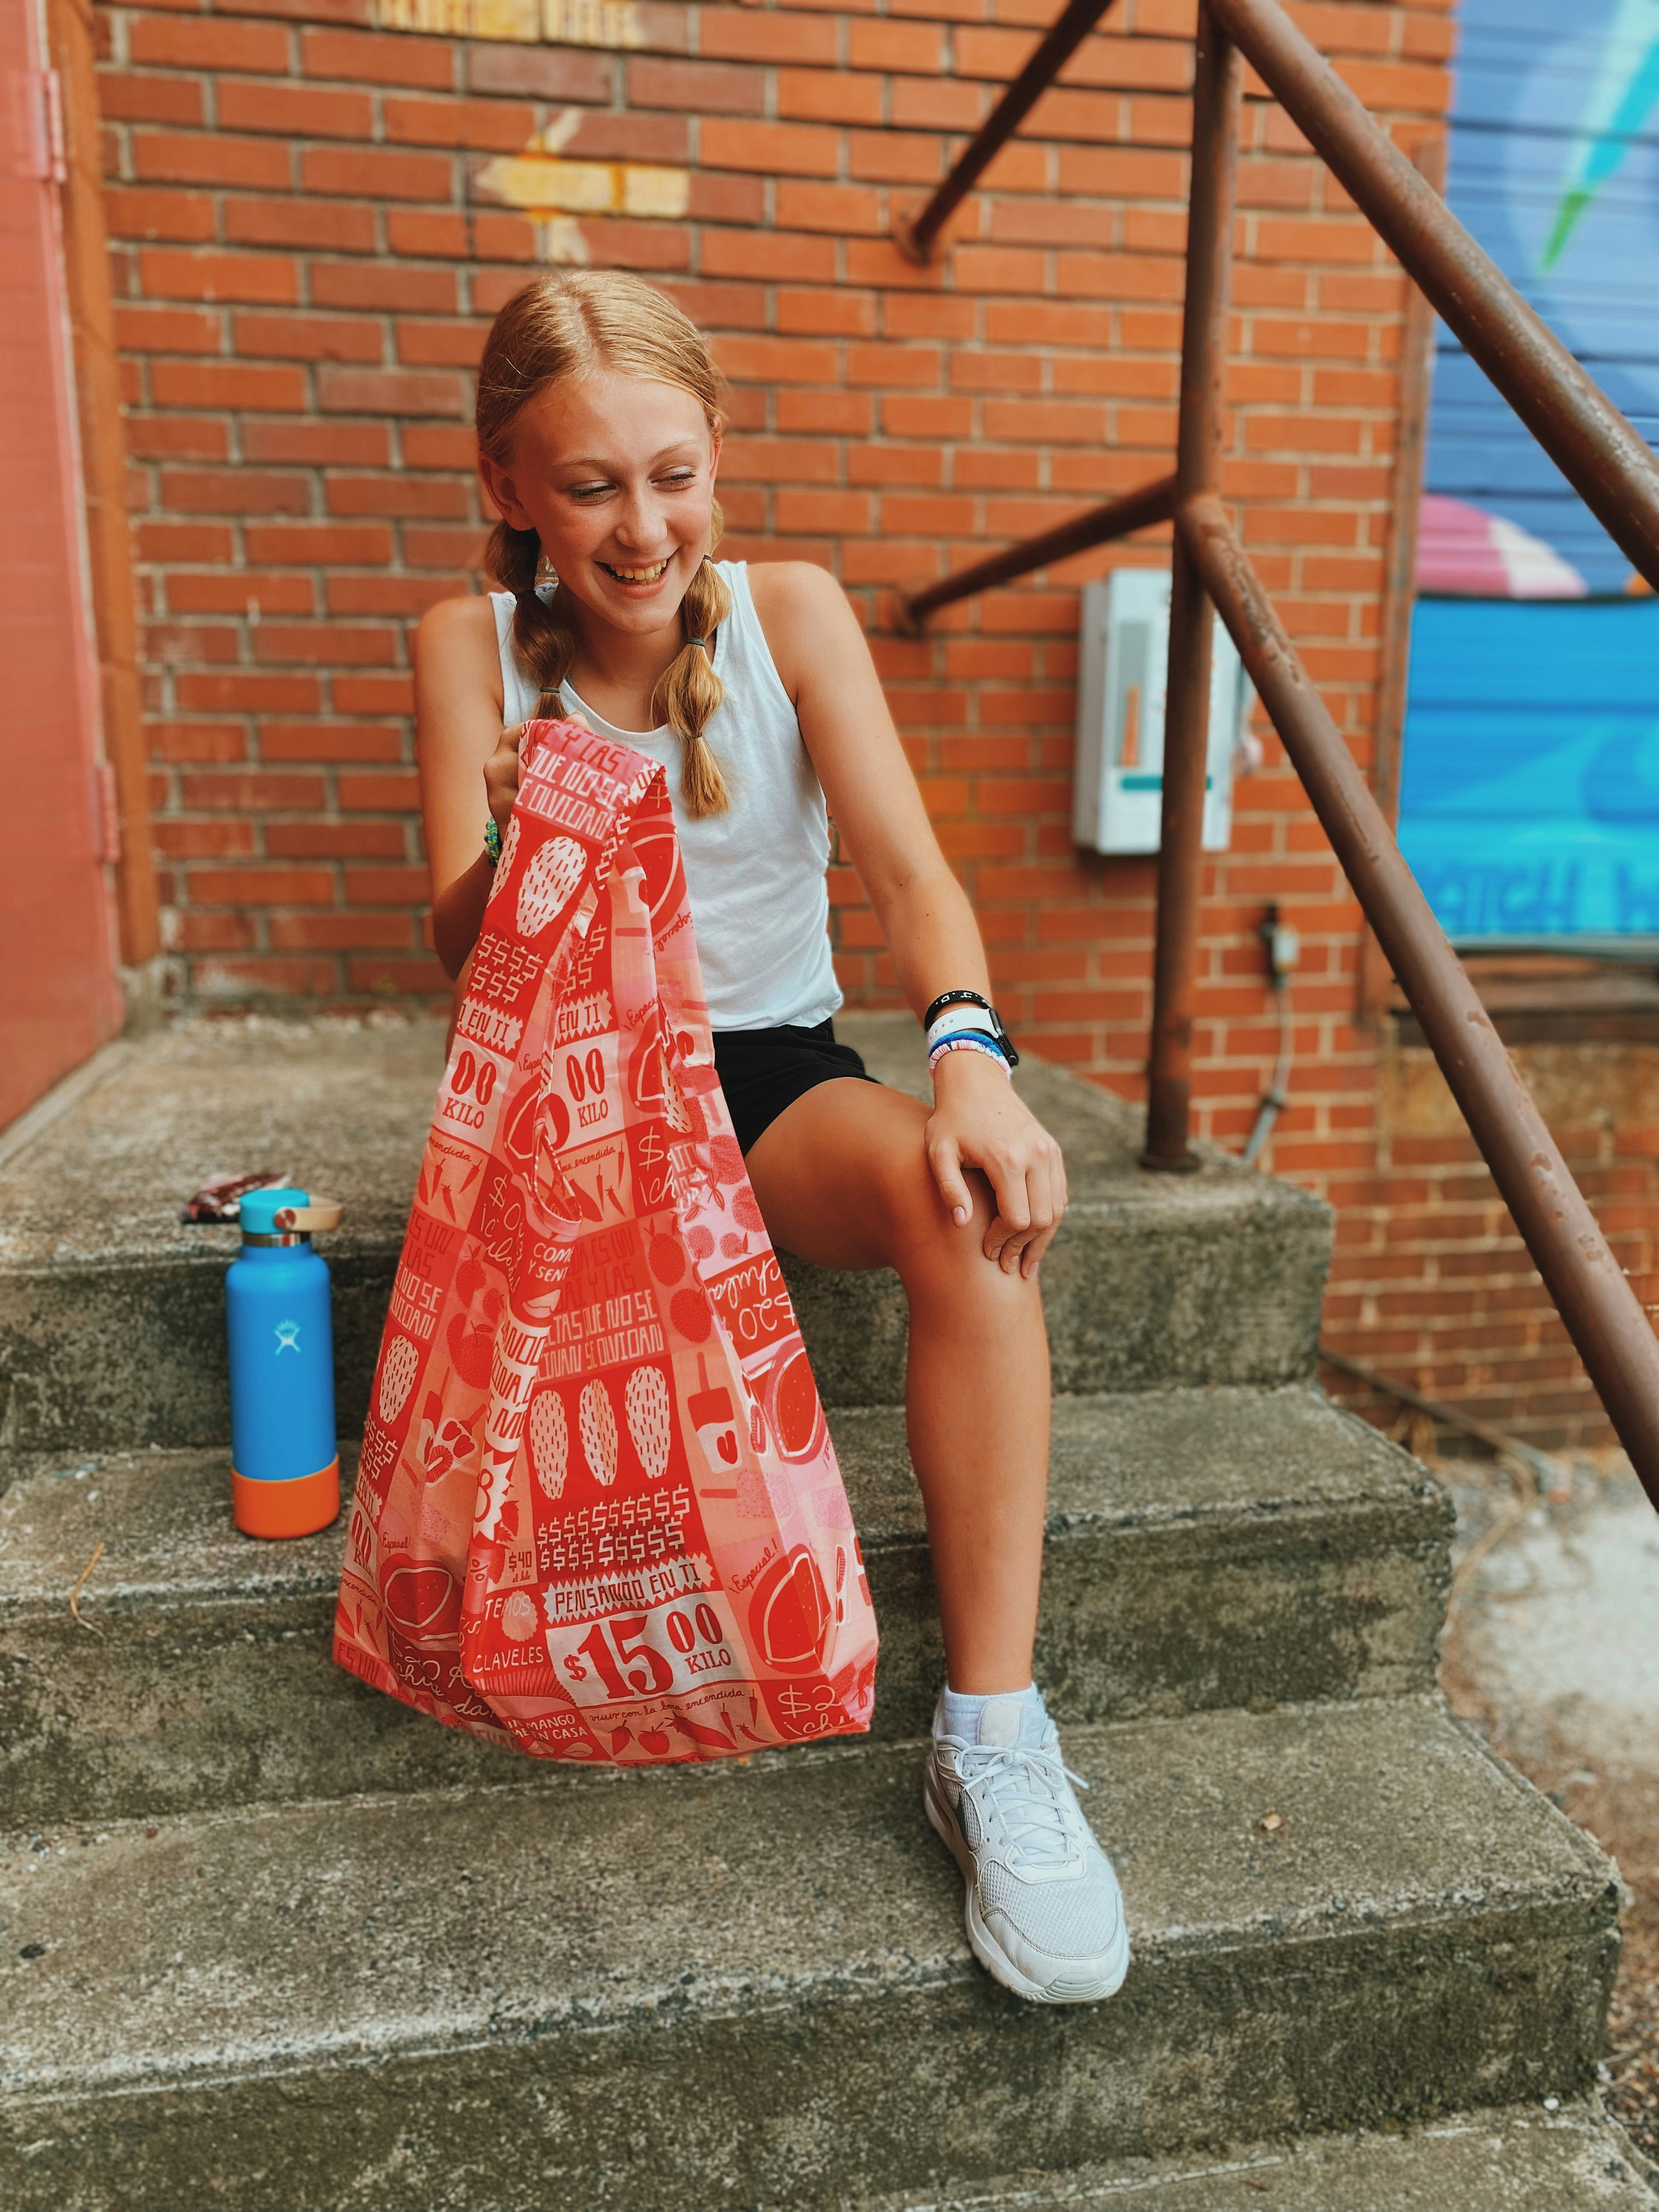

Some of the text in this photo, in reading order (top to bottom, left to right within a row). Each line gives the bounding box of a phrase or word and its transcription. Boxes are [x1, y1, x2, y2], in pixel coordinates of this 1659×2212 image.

[561, 730, 581, 753] Y
[579, 738, 625, 775] LAS
[559, 761, 601, 798] NO
[595, 776, 628, 811] SE
[467, 1008, 492, 1033] EN
[493, 1018, 510, 1043] TI
[558, 1002, 600, 1034] EN TI
[442, 1097, 484, 1130] KILO
[577, 1098, 608, 1128] KILO
[574, 1145, 616, 1169] encendida
[425, 1221, 455, 1255] UN
[591, 1234, 611, 1268] ES
[610, 1226, 635, 1261] UN
[406, 1240, 436, 1280] LAS
[528, 1259, 537, 1274] Y
[419, 1281, 443, 1313] SE
[589, 1271, 598, 1303] Y
[603, 1262, 636, 1297] LAS
[583, 1303, 605, 1340] QUE
[606, 1294, 633, 1330] NO
[634, 1289, 657, 1322] SE
[585, 1339, 598, 1370] SE
[596, 1323, 664, 1366] OLVIDAN
[509, 1551, 532, 1572] $40
[555, 1563, 702, 1615] PENSANDO EN TI
[472, 1646, 545, 1674] CLAVELES
[684, 1648, 731, 1675] KILO
[622, 1710, 643, 1719] con
[643, 1705, 657, 1716] la
[659, 1701, 684, 1712] boca
[685, 1688, 746, 1711] encendida
[526, 1714, 576, 1731] MANGO
[551, 1726, 589, 1740] CASA
